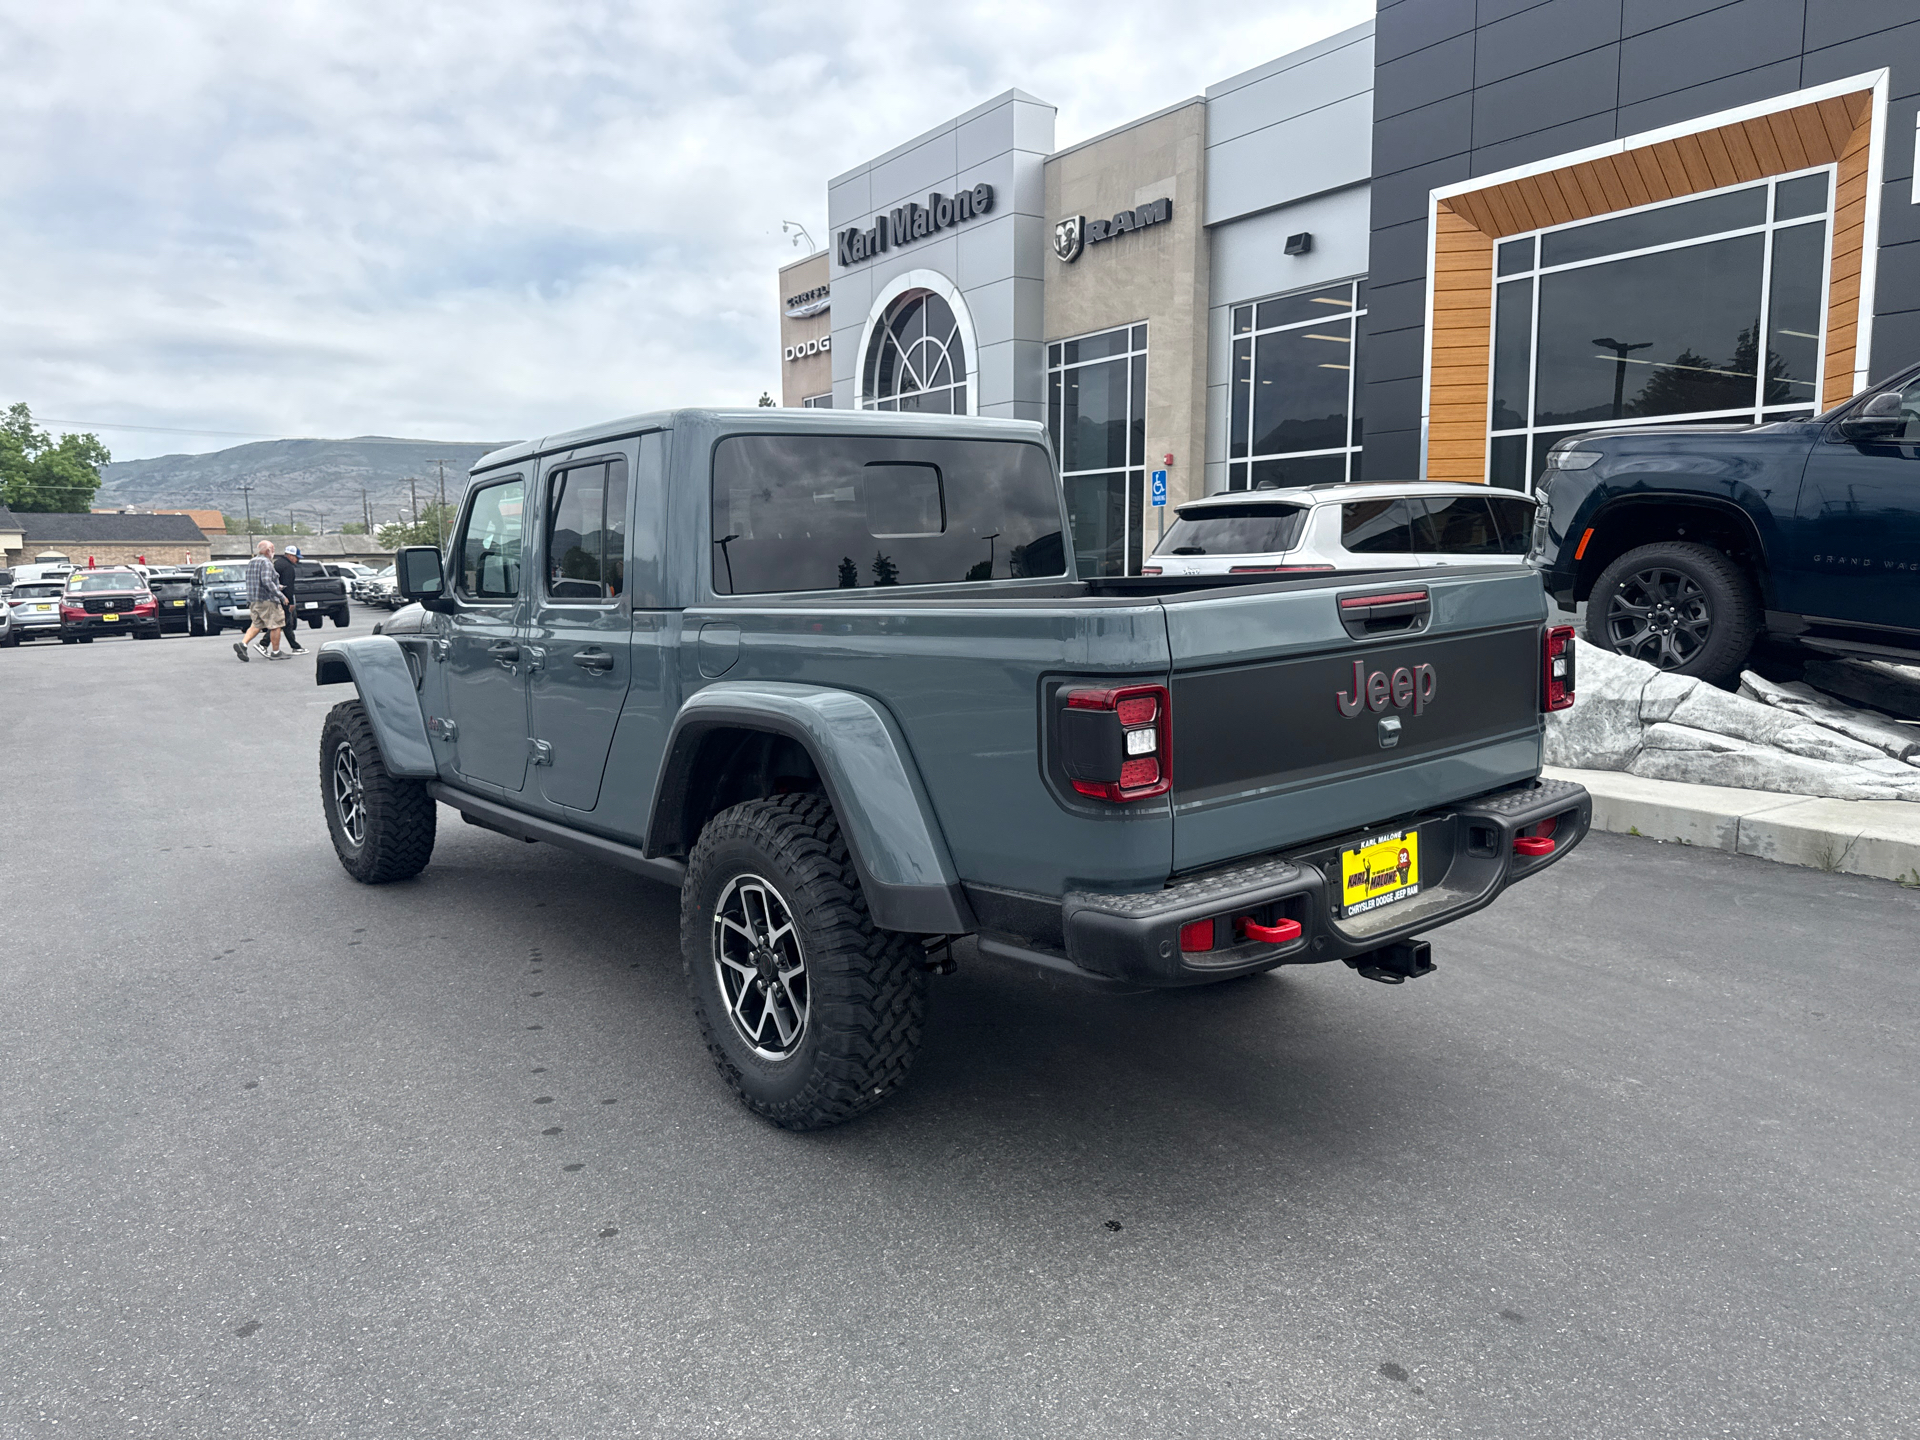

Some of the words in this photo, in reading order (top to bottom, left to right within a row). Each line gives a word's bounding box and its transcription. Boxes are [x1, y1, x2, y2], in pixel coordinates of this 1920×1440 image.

[837, 215, 887, 267] Karl
[890, 183, 994, 247] Malone
[1085, 197, 1172, 245] RAM
[787, 283, 830, 307] CHRYSL
[784, 335, 831, 361] DODG
[1813, 554, 1871, 567] GRAND
[1884, 560, 1919, 571] WAG
[1336, 659, 1437, 719] Jeep
[1360, 838, 1377, 849] KARL
[1378, 831, 1402, 843] MALONE
[1400, 852, 1408, 863] 32
[1348, 899, 1375, 916] CHRYSLER
[1376, 892, 1394, 906] DODGE
[1394, 888, 1407, 901] JEEP
[1406, 884, 1419, 896] RAM
